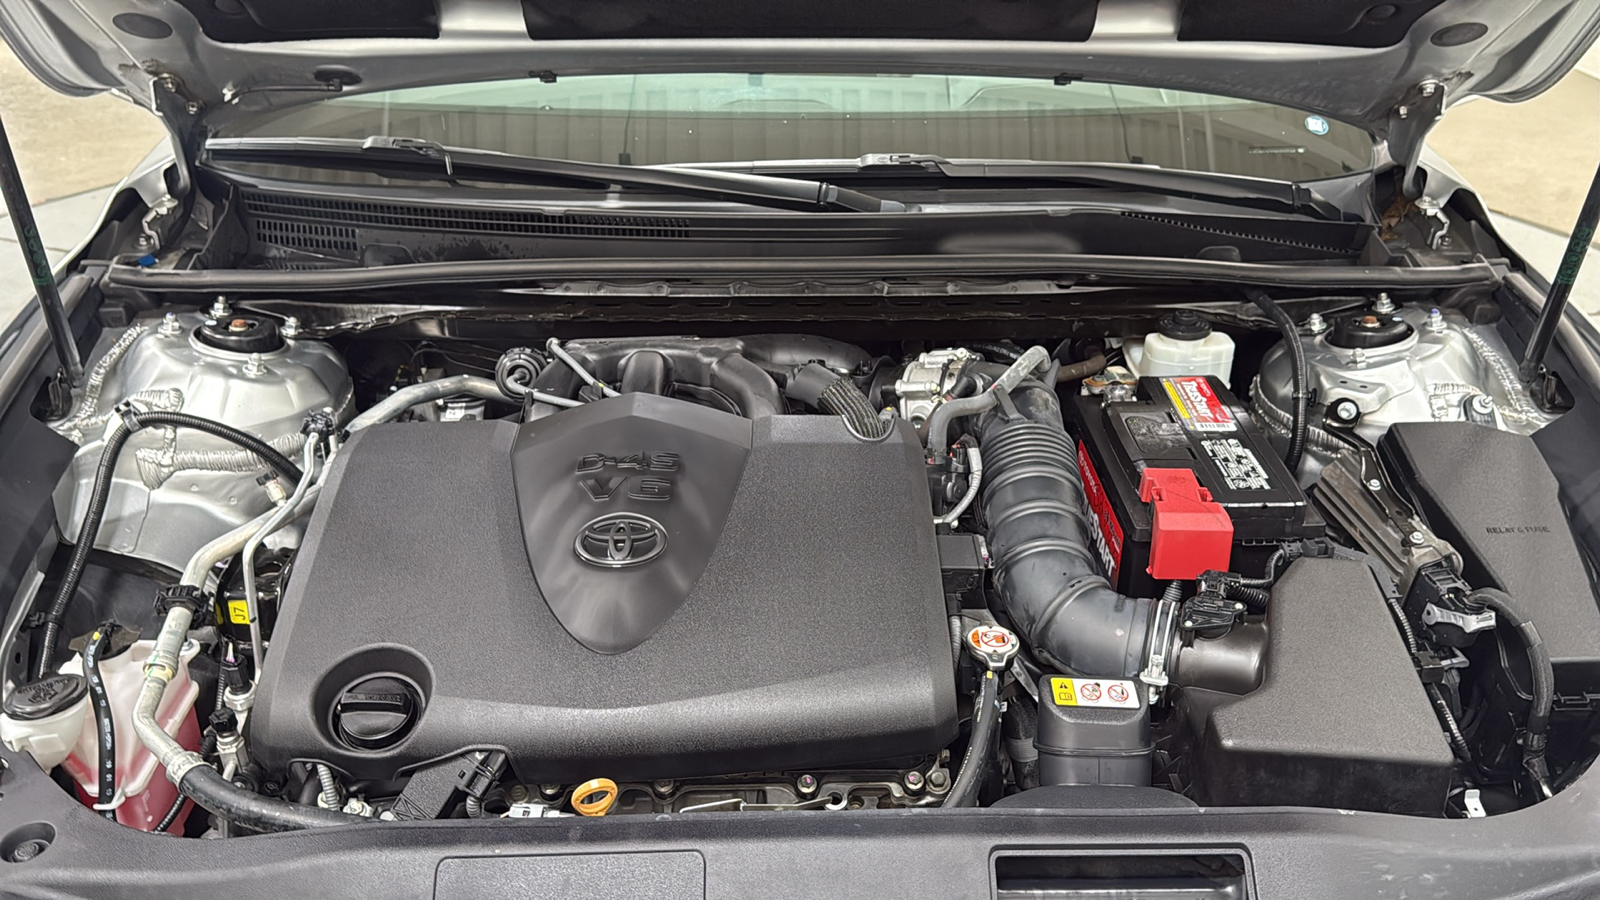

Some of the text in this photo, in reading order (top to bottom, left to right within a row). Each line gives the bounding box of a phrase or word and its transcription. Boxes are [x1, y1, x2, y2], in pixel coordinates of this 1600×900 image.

[575, 451, 679, 474] D-4S
[580, 476, 672, 501] V6
[1485, 526, 1514, 534] RELAY
[233, 606, 246, 621] J7
